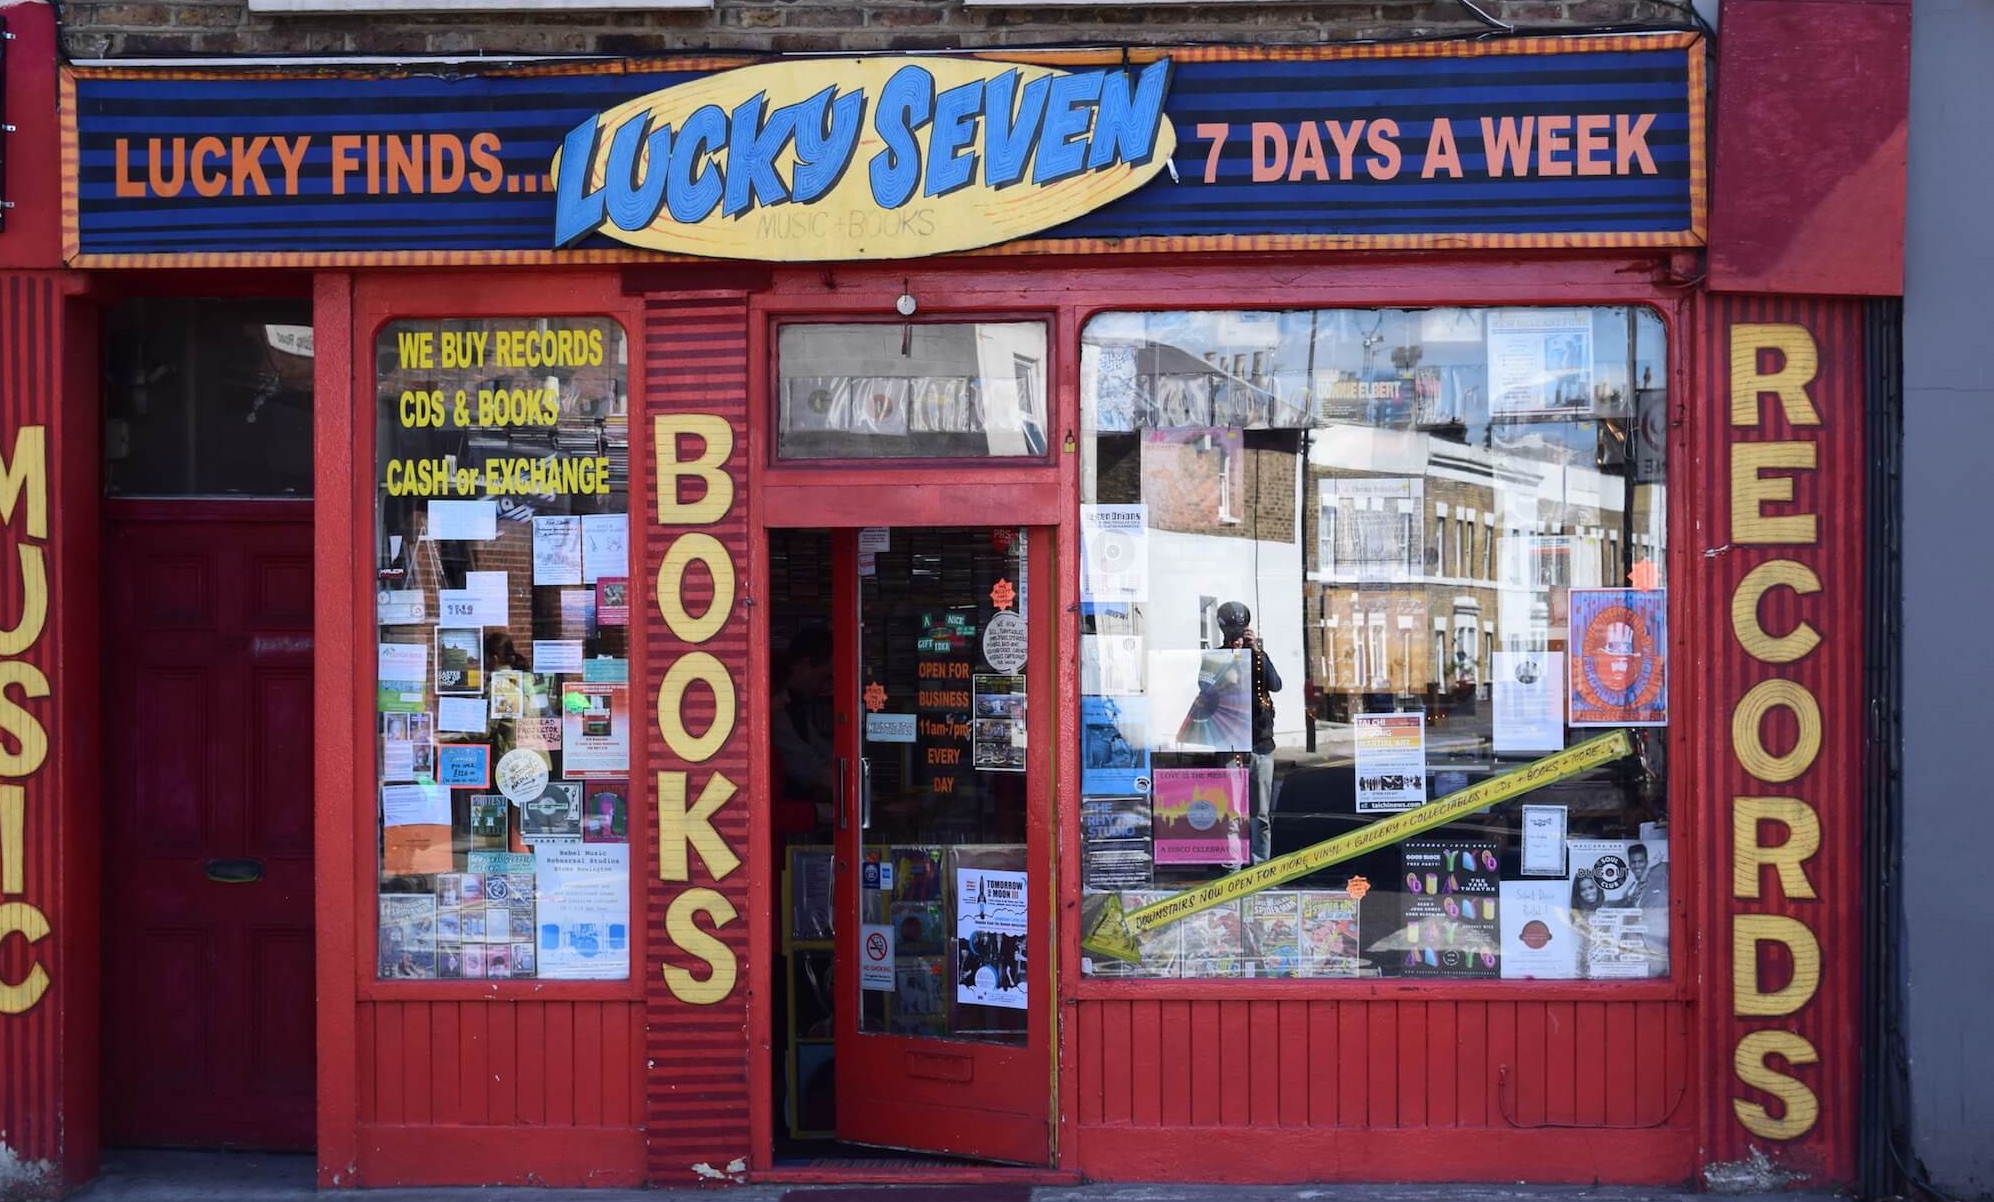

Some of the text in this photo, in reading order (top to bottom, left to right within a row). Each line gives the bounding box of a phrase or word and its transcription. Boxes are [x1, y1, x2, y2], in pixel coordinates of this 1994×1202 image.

[554, 57, 1174, 251] LUCKY SEVEN
[1196, 113, 1659, 184] 7 DAYS A WEEK
[115, 136, 311, 198] LUCKY
[757, 213, 829, 240] MUSIC
[398, 329, 604, 369] WE BUY RECORDS
[400, 389, 560, 428] CDS & BOOKS
[386, 456, 611, 497] CASH or EXCHANGE
[993, 529, 1012, 538] PRS
[947, 614, 965, 625] NICE
[918, 639, 934, 650] GIFT
[919, 662, 969, 678] OPEN FOR
[919, 690, 969, 708] BUSINESS
[654, 414, 742, 1006] BOOKS
[0, 424, 51, 1016] MUSIC
[919, 719, 971, 740] 11am-7pm
[1729, 323, 1826, 1141] RECORDS
[928, 748, 961, 764] EVERY
[933, 776, 954, 793] DAY
[1087, 802, 1113, 813] THE
[1088, 826, 1136, 838] STUDIO
[1136, 894, 1195, 929] DOWNSTAIRS
[1199, 887, 1224, 903] NOW
[1227, 875, 1253, 893] OPEN
[1257, 866, 1277, 882] FOR
[1280, 855, 1308, 874] MORE
[1354, 822, 1400, 848] GALLERY
[1526, 760, 1559, 781] BOOKS
[1600, 856, 1619, 864] SOUL
[987, 880, 1023, 890] TOMORROW
[1600, 880, 1619, 889] CLUB
[993, 889, 1011, 899] MOON
